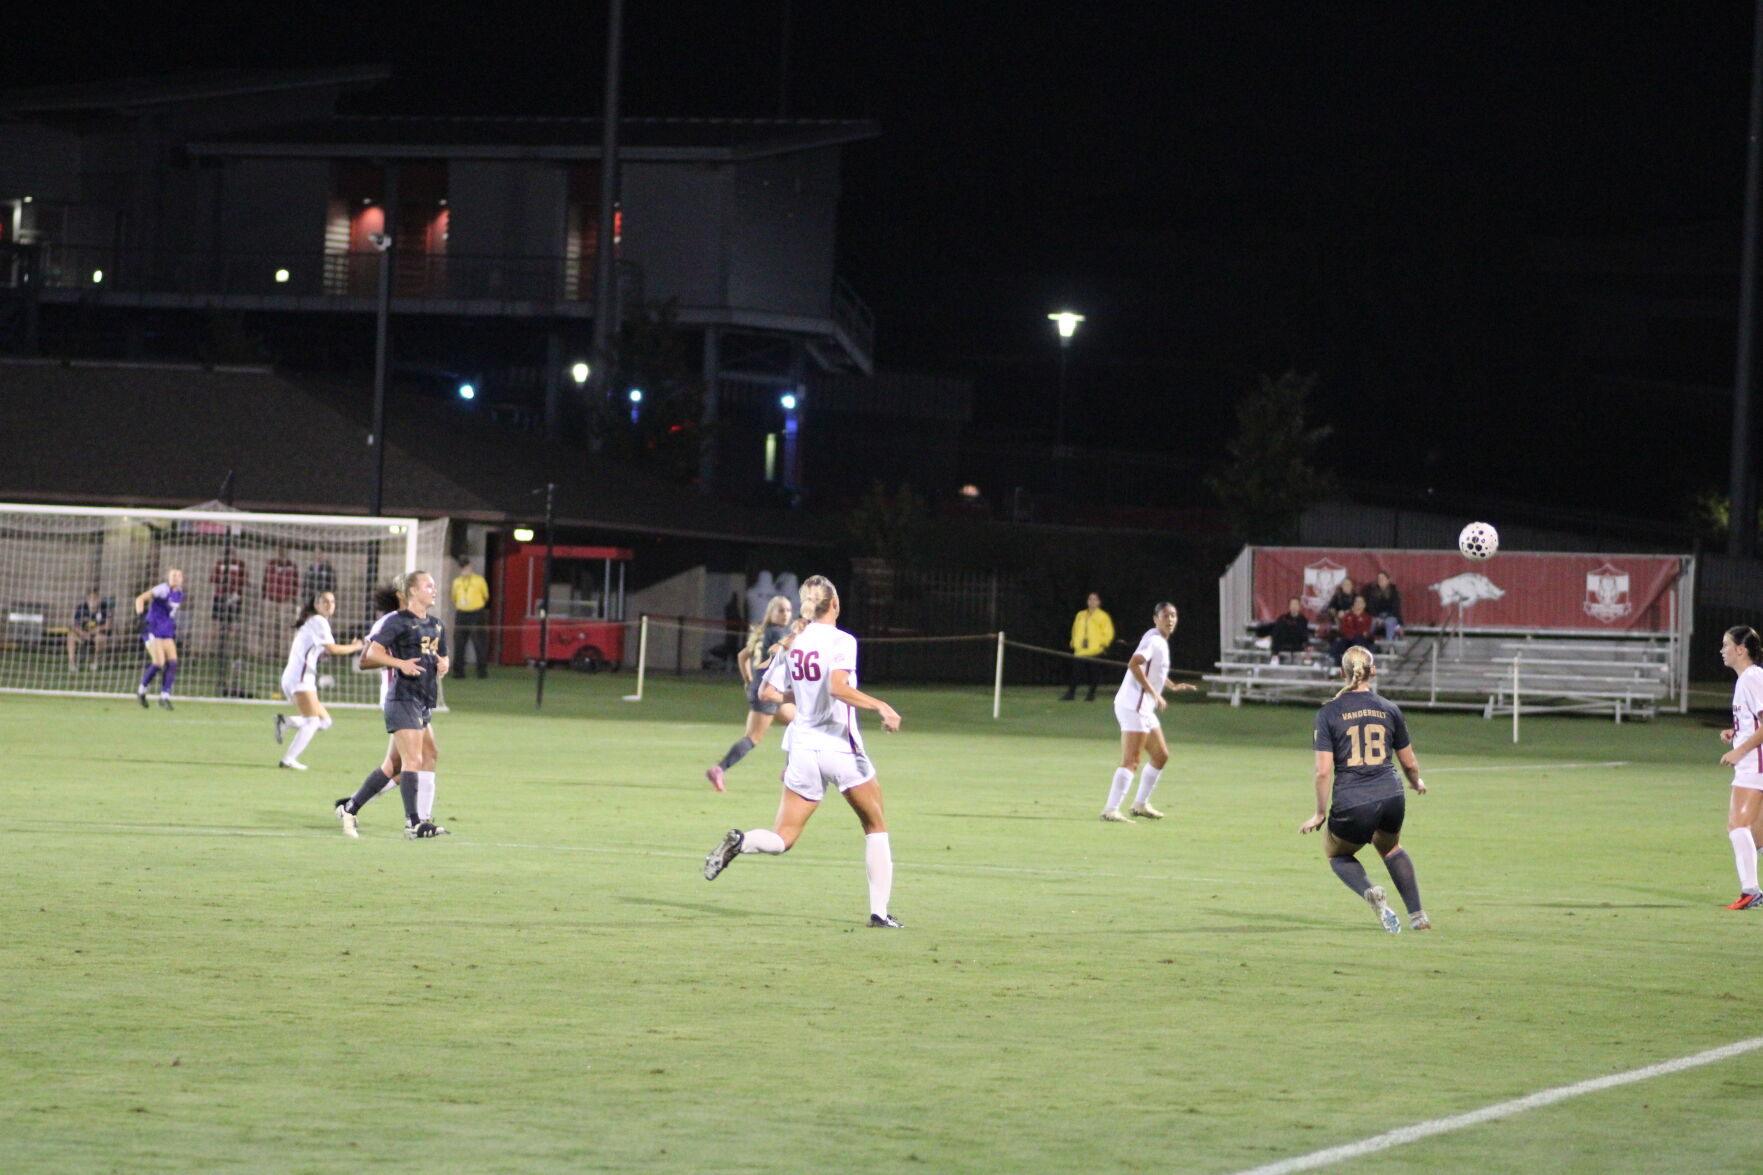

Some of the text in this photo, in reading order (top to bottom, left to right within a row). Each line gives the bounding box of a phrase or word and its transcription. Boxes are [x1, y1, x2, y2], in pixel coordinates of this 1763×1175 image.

[420, 636, 440, 654] 24
[790, 649, 822, 682] 36
[1342, 708, 1387, 721] VANDERBILT
[1346, 724, 1387, 767] 18
